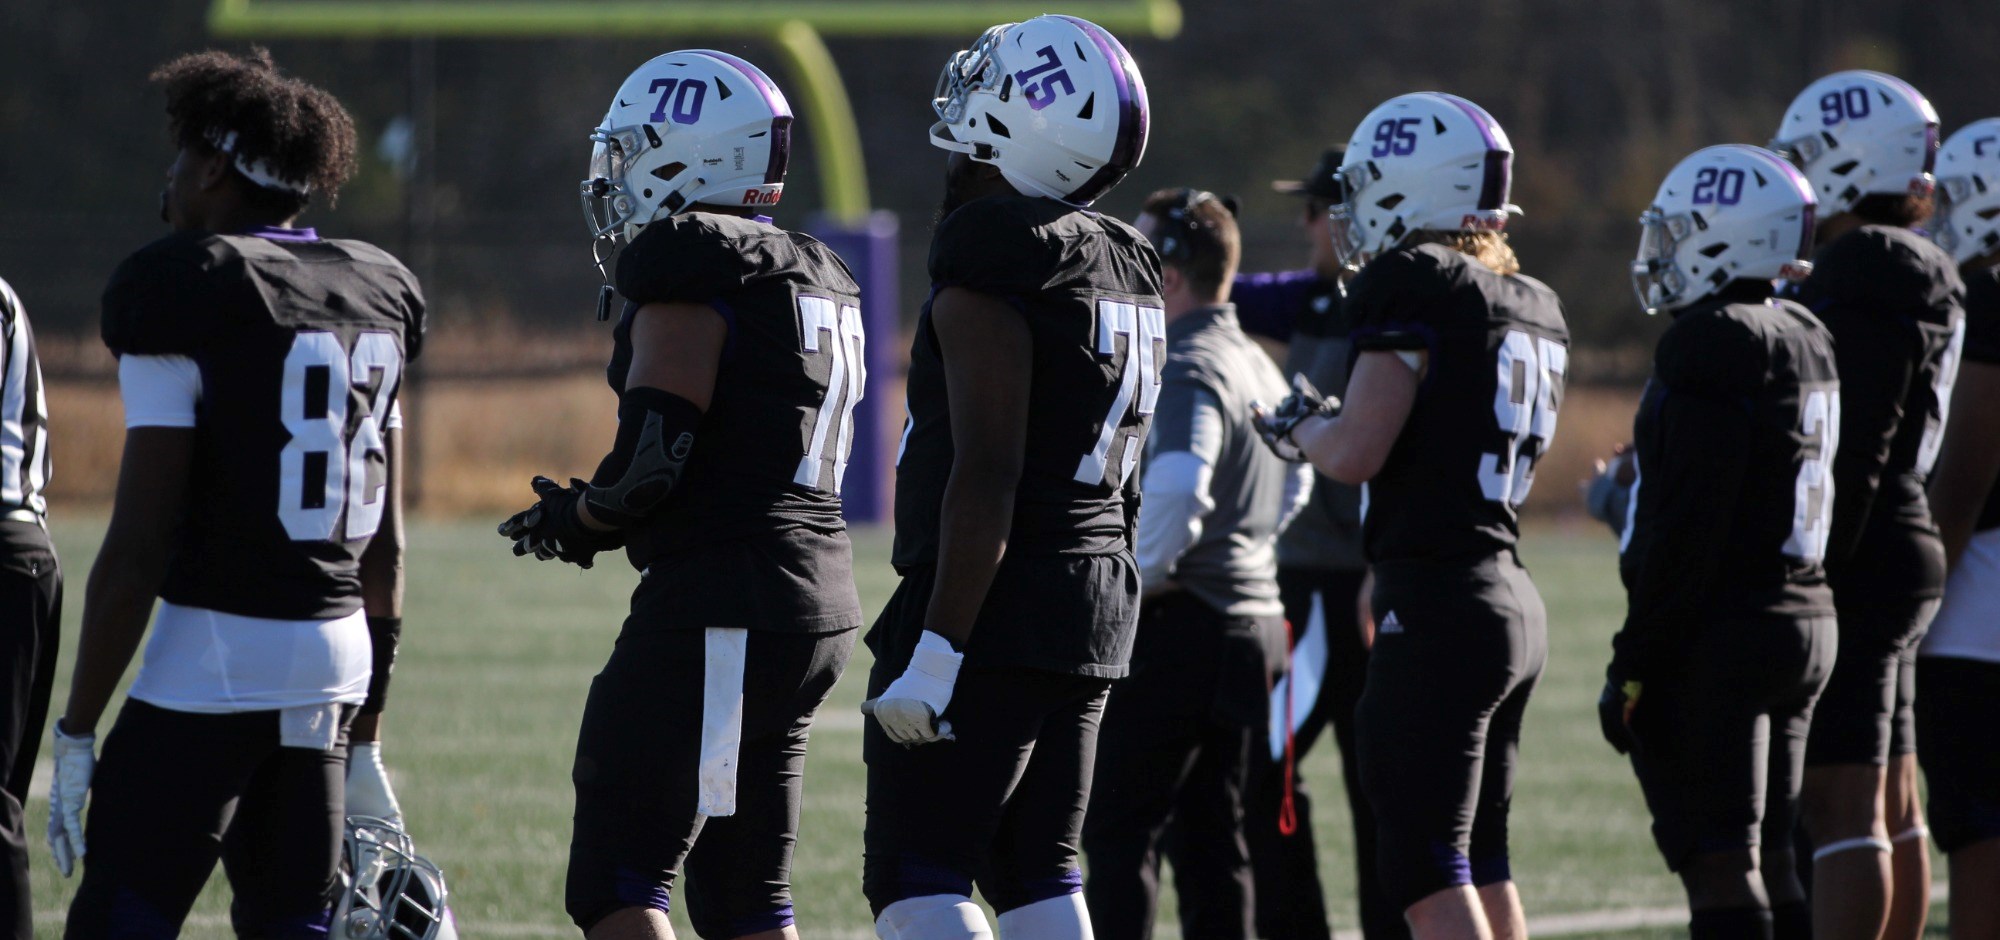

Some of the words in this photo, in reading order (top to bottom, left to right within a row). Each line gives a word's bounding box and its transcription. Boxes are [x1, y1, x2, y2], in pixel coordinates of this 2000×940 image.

[1015, 45, 1076, 111] 75
[648, 78, 707, 125] 70
[1820, 86, 1870, 126] 90
[1371, 118, 1421, 158] 95
[1693, 167, 1745, 205] 20
[278, 330, 400, 541] 82
